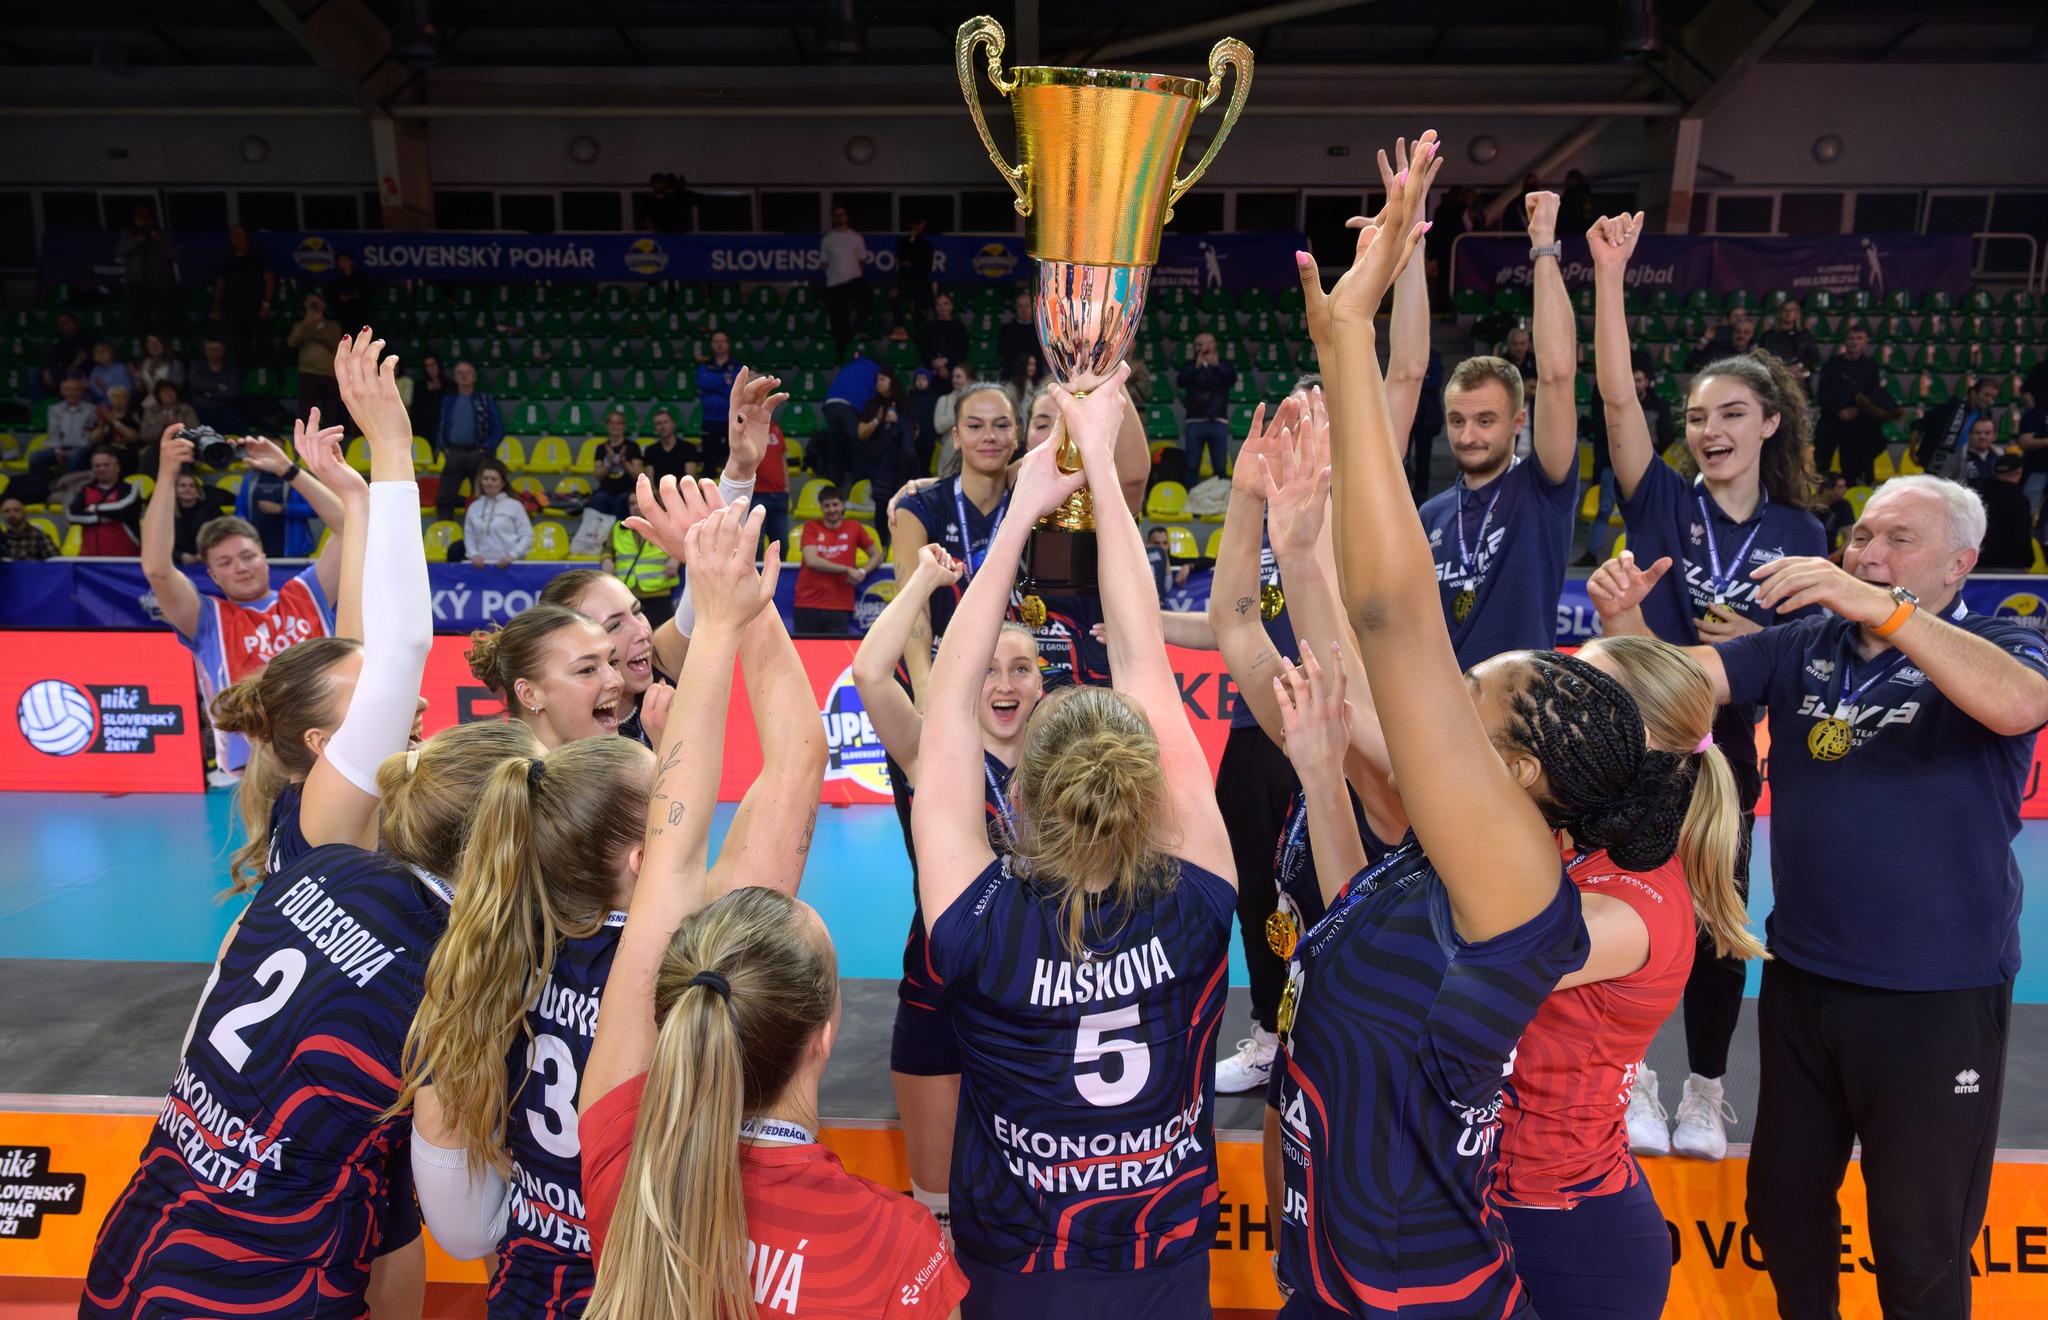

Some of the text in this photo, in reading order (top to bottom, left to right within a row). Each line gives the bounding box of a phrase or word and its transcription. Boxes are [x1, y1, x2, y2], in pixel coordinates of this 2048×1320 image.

[363, 243, 501, 268] SLOVENSKÝ
[510, 243, 595, 268] POHÁR
[711, 249, 821, 271] SLOVENS
[101, 686, 139, 709] niké
[102, 711, 177, 727] SLOVENSKÝ
[103, 725, 149, 739] POHÁR
[104, 736, 140, 752] ŽENY
[274, 875, 407, 989] FÖLDESIOVÁ
[208, 947, 308, 1074] 2
[1073, 1003, 1151, 1107] 5
[526, 1033, 581, 1158] 3
[174, 1057, 292, 1172] ONOMICKÁ
[760, 1123, 807, 1142] FEDERÁCIA
[1003, 1134, 1203, 1193] UNIVERZITA
[0, 1183, 76, 1202] OVENSKÝ
[0, 1199, 36, 1218] HÁR
[511, 1182, 592, 1252] NIVER
[0, 1216, 19, 1235] ŽI
[747, 1239, 809, 1315] VÁ
[914, 1250, 944, 1287] Klinika
